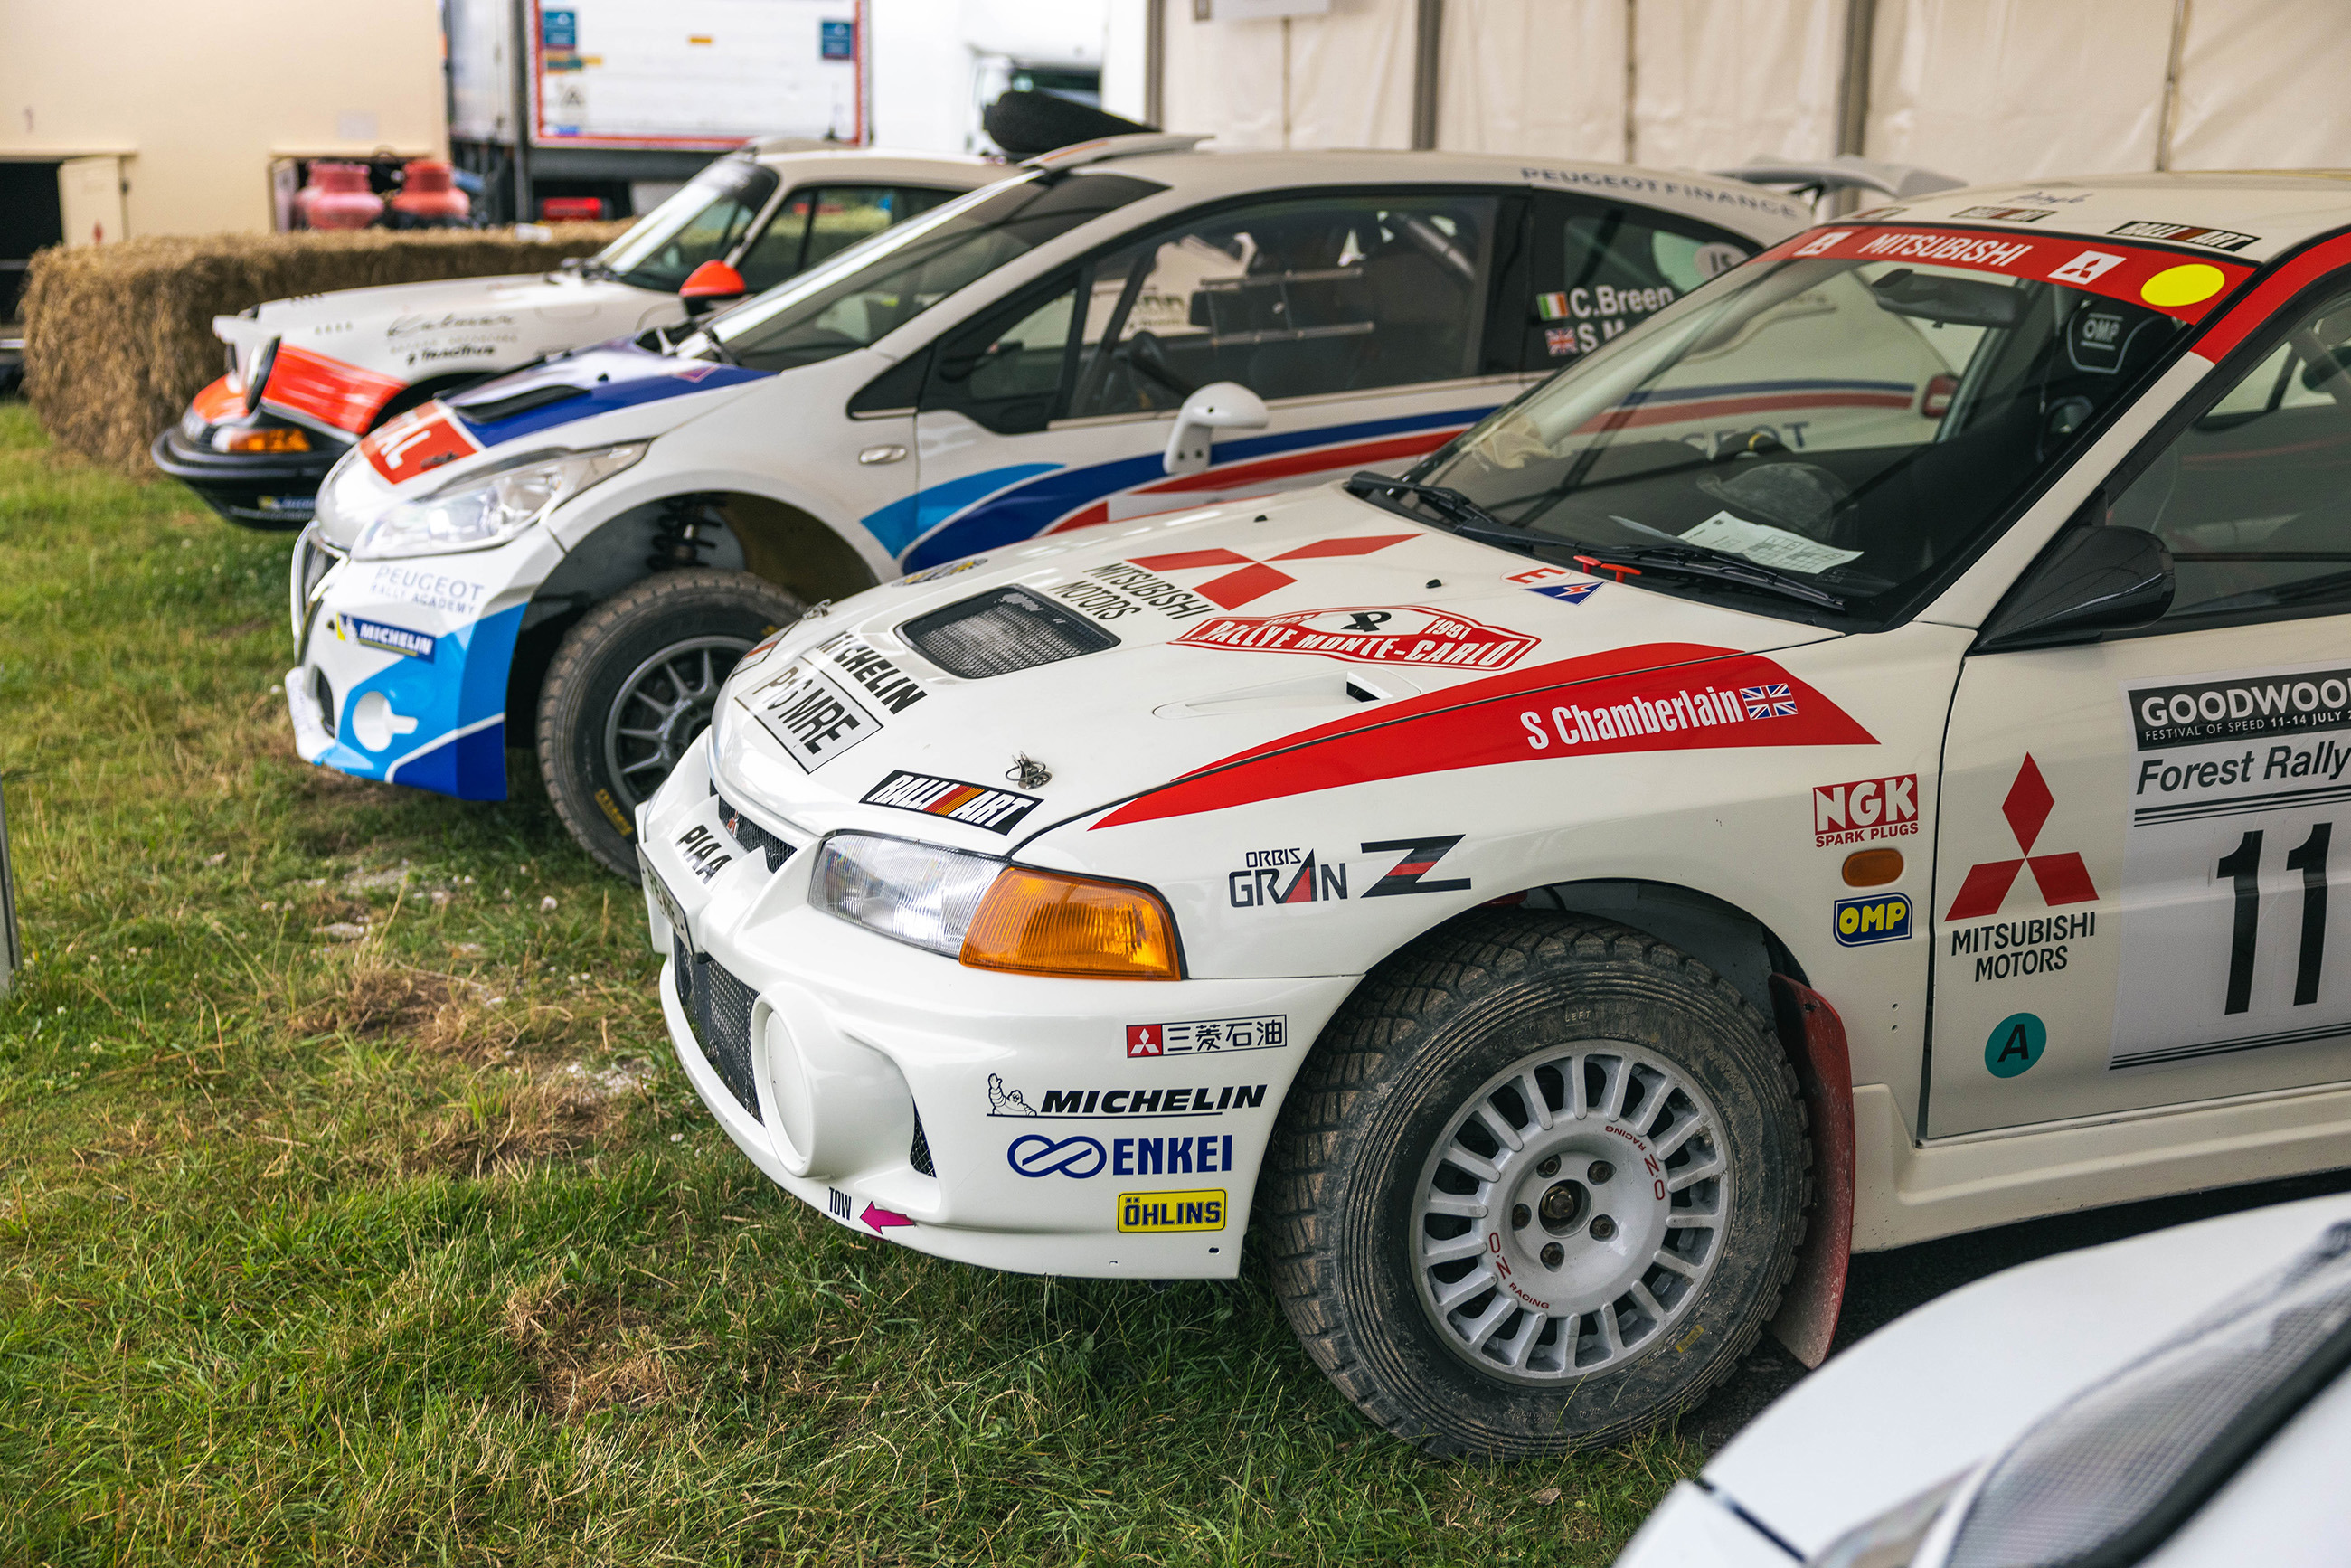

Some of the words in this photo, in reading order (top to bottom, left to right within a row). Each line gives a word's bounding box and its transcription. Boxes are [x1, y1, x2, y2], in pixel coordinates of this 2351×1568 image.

[1520, 166, 1657, 193] PEUGEOT
[1665, 183, 1797, 218] FINANCE
[1856, 233, 2034, 267] MITSUBISHI
[1569, 284, 1674, 317] C.Breen
[1577, 322, 1600, 354] S
[2082, 318, 2120, 343] OMP
[374, 563, 485, 602] PEUGEOT
[1047, 580, 1143, 620] MOTORS
[1082, 562, 1216, 620] MITSUBISHI
[411, 592, 476, 615] ACADEMY
[359, 622, 433, 656] MICHELIN
[1181, 620, 1298, 647] RALLYE
[1293, 636, 1521, 666] MONTE-CARLO
[817, 631, 928, 715] MICHELIN
[778, 687, 861, 755] MRE
[1520, 711, 1550, 750] S
[1551, 686, 1745, 745] Chamberlain
[2145, 725, 2202, 741] FESTIVAL
[2206, 723, 2223, 734] OF
[2228, 718, 2265, 732] SPEED
[2271, 716, 2307, 727] 11-14
[2312, 710, 2342, 726] JULY
[2136, 751, 2255, 796] Forest
[2263, 740, 2351, 781] Rally
[1815, 776, 1918, 832] NGK
[1816, 831, 1865, 848] SPARK
[1870, 822, 1919, 841] PLUGS
[675, 824, 732, 885] PIAA
[1229, 848, 1348, 908] GRAN
[1359, 834, 1472, 898] Z
[1245, 847, 1302, 868] ORBIS
[1838, 902, 1907, 935] OMP
[1951, 911, 2097, 956] MITSUBISHI
[2216, 822, 2333, 1015] 11
[1975, 945, 2069, 983] MOTORS
[1564, 1010, 1591, 1023] LEFT
[1166, 1019, 1283, 1053] 三菱石油
[1997, 1024, 2030, 1063] A
[1040, 1084, 1268, 1114] MICHELIN
[1112, 1134, 1233, 1176] ENKEI
[1605, 1125, 1647, 1152] RACING
[828, 1186, 852, 1221] TOW
[1123, 1195, 1223, 1227] ÖHLINS
[1508, 1282, 1550, 1310] RACING
